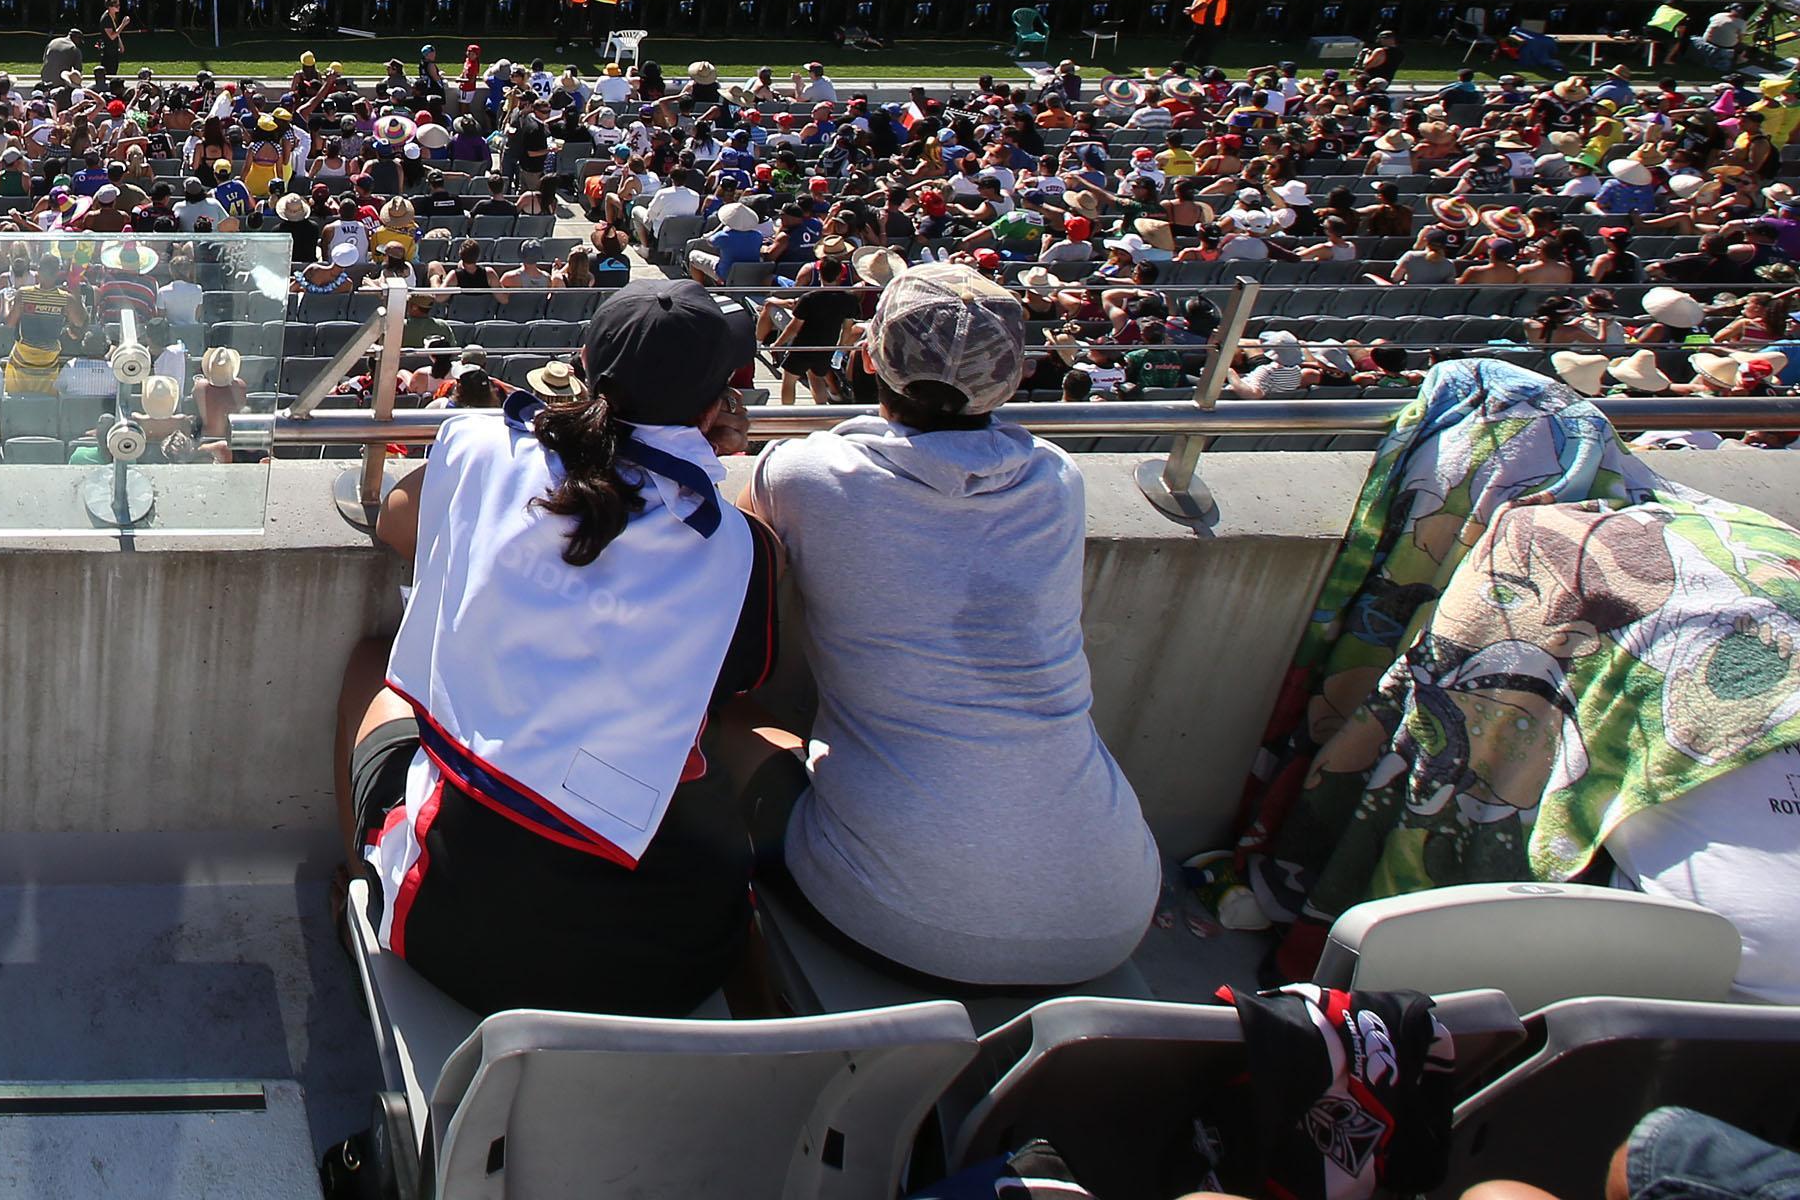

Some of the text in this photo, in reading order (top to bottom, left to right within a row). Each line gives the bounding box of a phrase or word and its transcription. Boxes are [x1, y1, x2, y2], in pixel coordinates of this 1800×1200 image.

[532, 82, 551, 98] 24
[230, 201, 246, 217] 47
[341, 226, 360, 235] WADE
